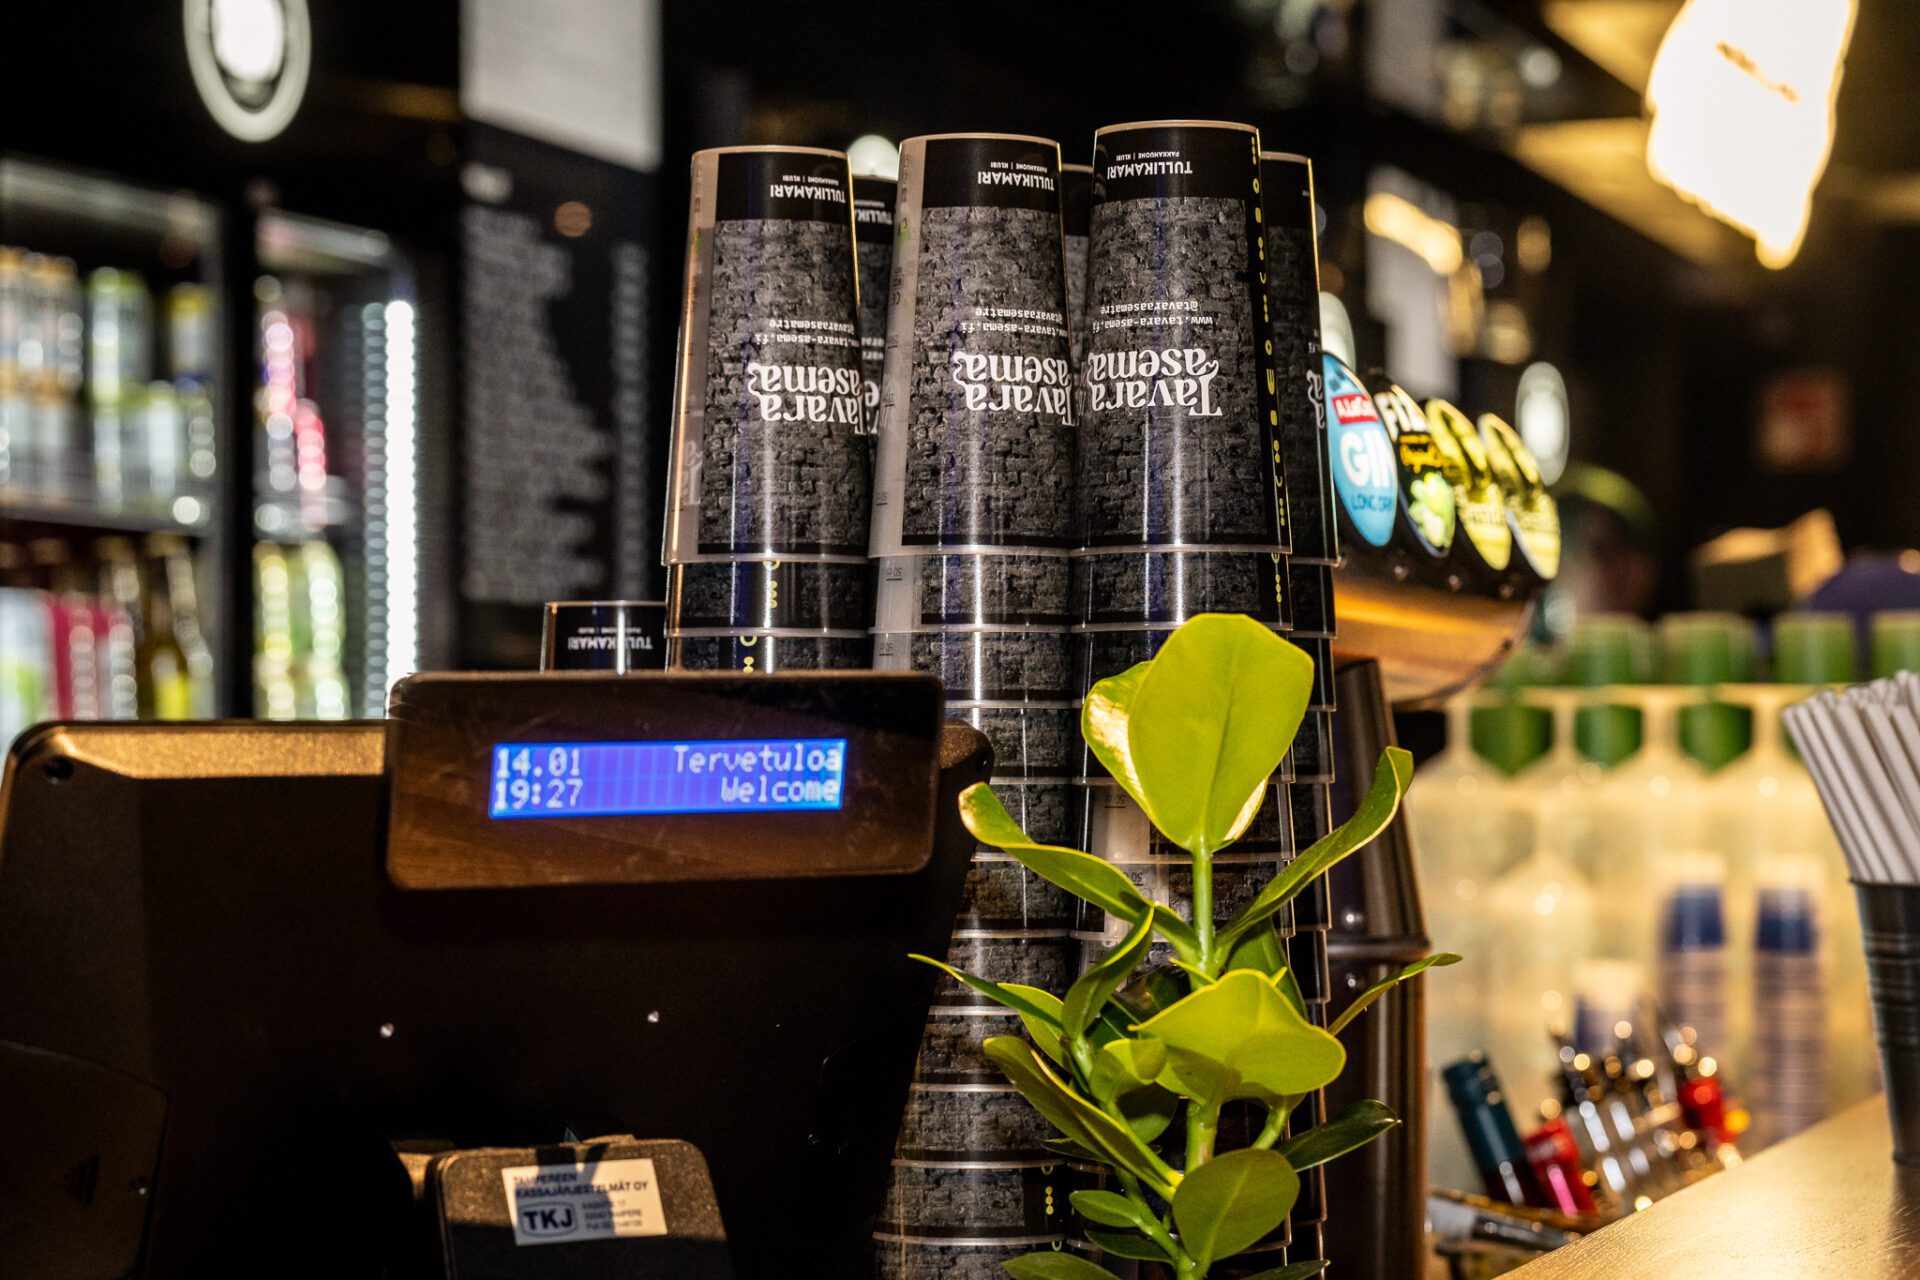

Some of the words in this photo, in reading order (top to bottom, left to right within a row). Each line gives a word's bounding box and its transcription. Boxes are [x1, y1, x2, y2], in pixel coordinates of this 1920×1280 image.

[1138, 151, 1180, 159] PAKKAHUONE
[977, 171, 1055, 191] TULLIKAMARI
[1107, 161, 1193, 180] TULLIKAMARI
[770, 185, 846, 204] TULLIKAMARI
[1100, 301, 1199, 315] @tavaraasematre
[1092, 316, 1213, 334] www.tavara-asema.fi
[953, 351, 1069, 386] asema
[1087, 348, 1208, 381] asema
[748, 362, 862, 396] asema
[960, 382, 1074, 427] Tavara
[1088, 371, 1222, 416] Tavara
[755, 394, 866, 435] Tavara
[567, 636, 653, 650] TULKAMARI
[497, 747, 581, 778] 14.01
[673, 742, 842, 773] Tervetuloa
[494, 778, 583, 810] 19:27
[721, 775, 839, 803] Welcome
[634, 1180, 648, 1191] OY
[523, 1208, 573, 1230] TKJ
